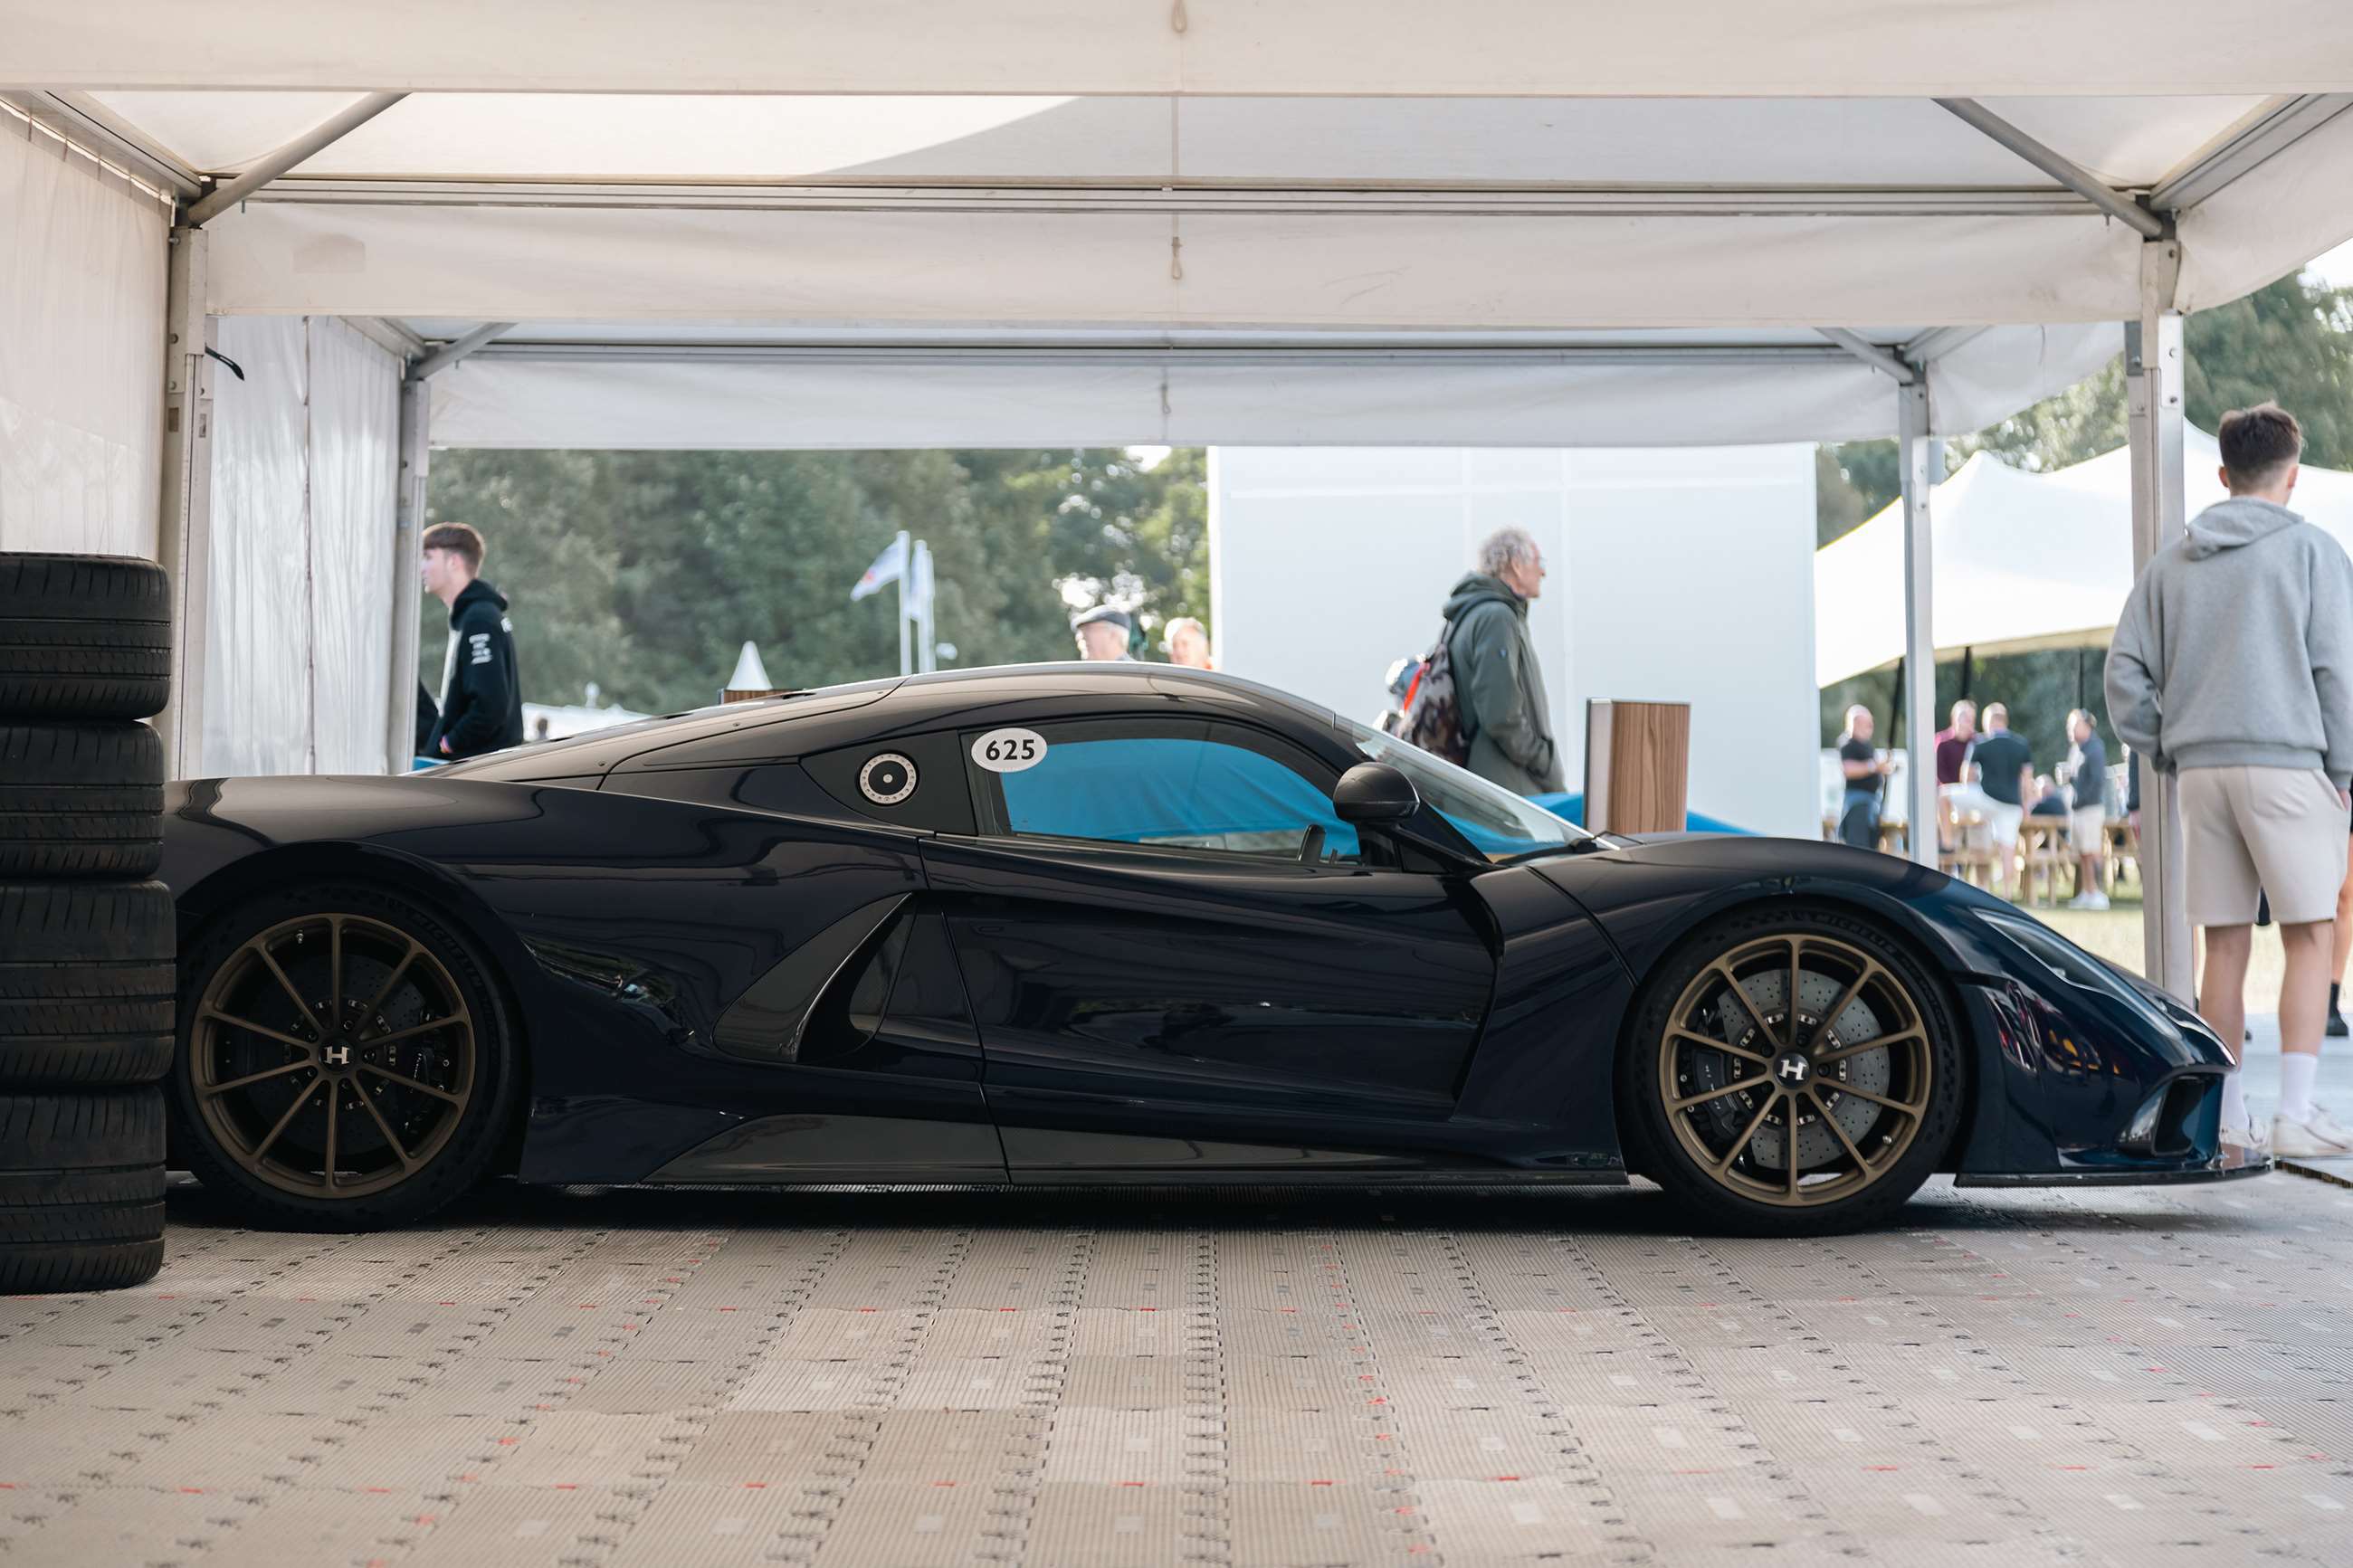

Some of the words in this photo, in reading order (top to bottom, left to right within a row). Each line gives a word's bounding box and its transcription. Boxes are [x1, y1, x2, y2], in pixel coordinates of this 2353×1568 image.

[985, 739, 1035, 761] 625
[1815, 913, 1898, 955] MICHELIN
[410, 910, 485, 991] MICHELIN
[323, 1046, 350, 1065] H
[1777, 1059, 1806, 1080] H
